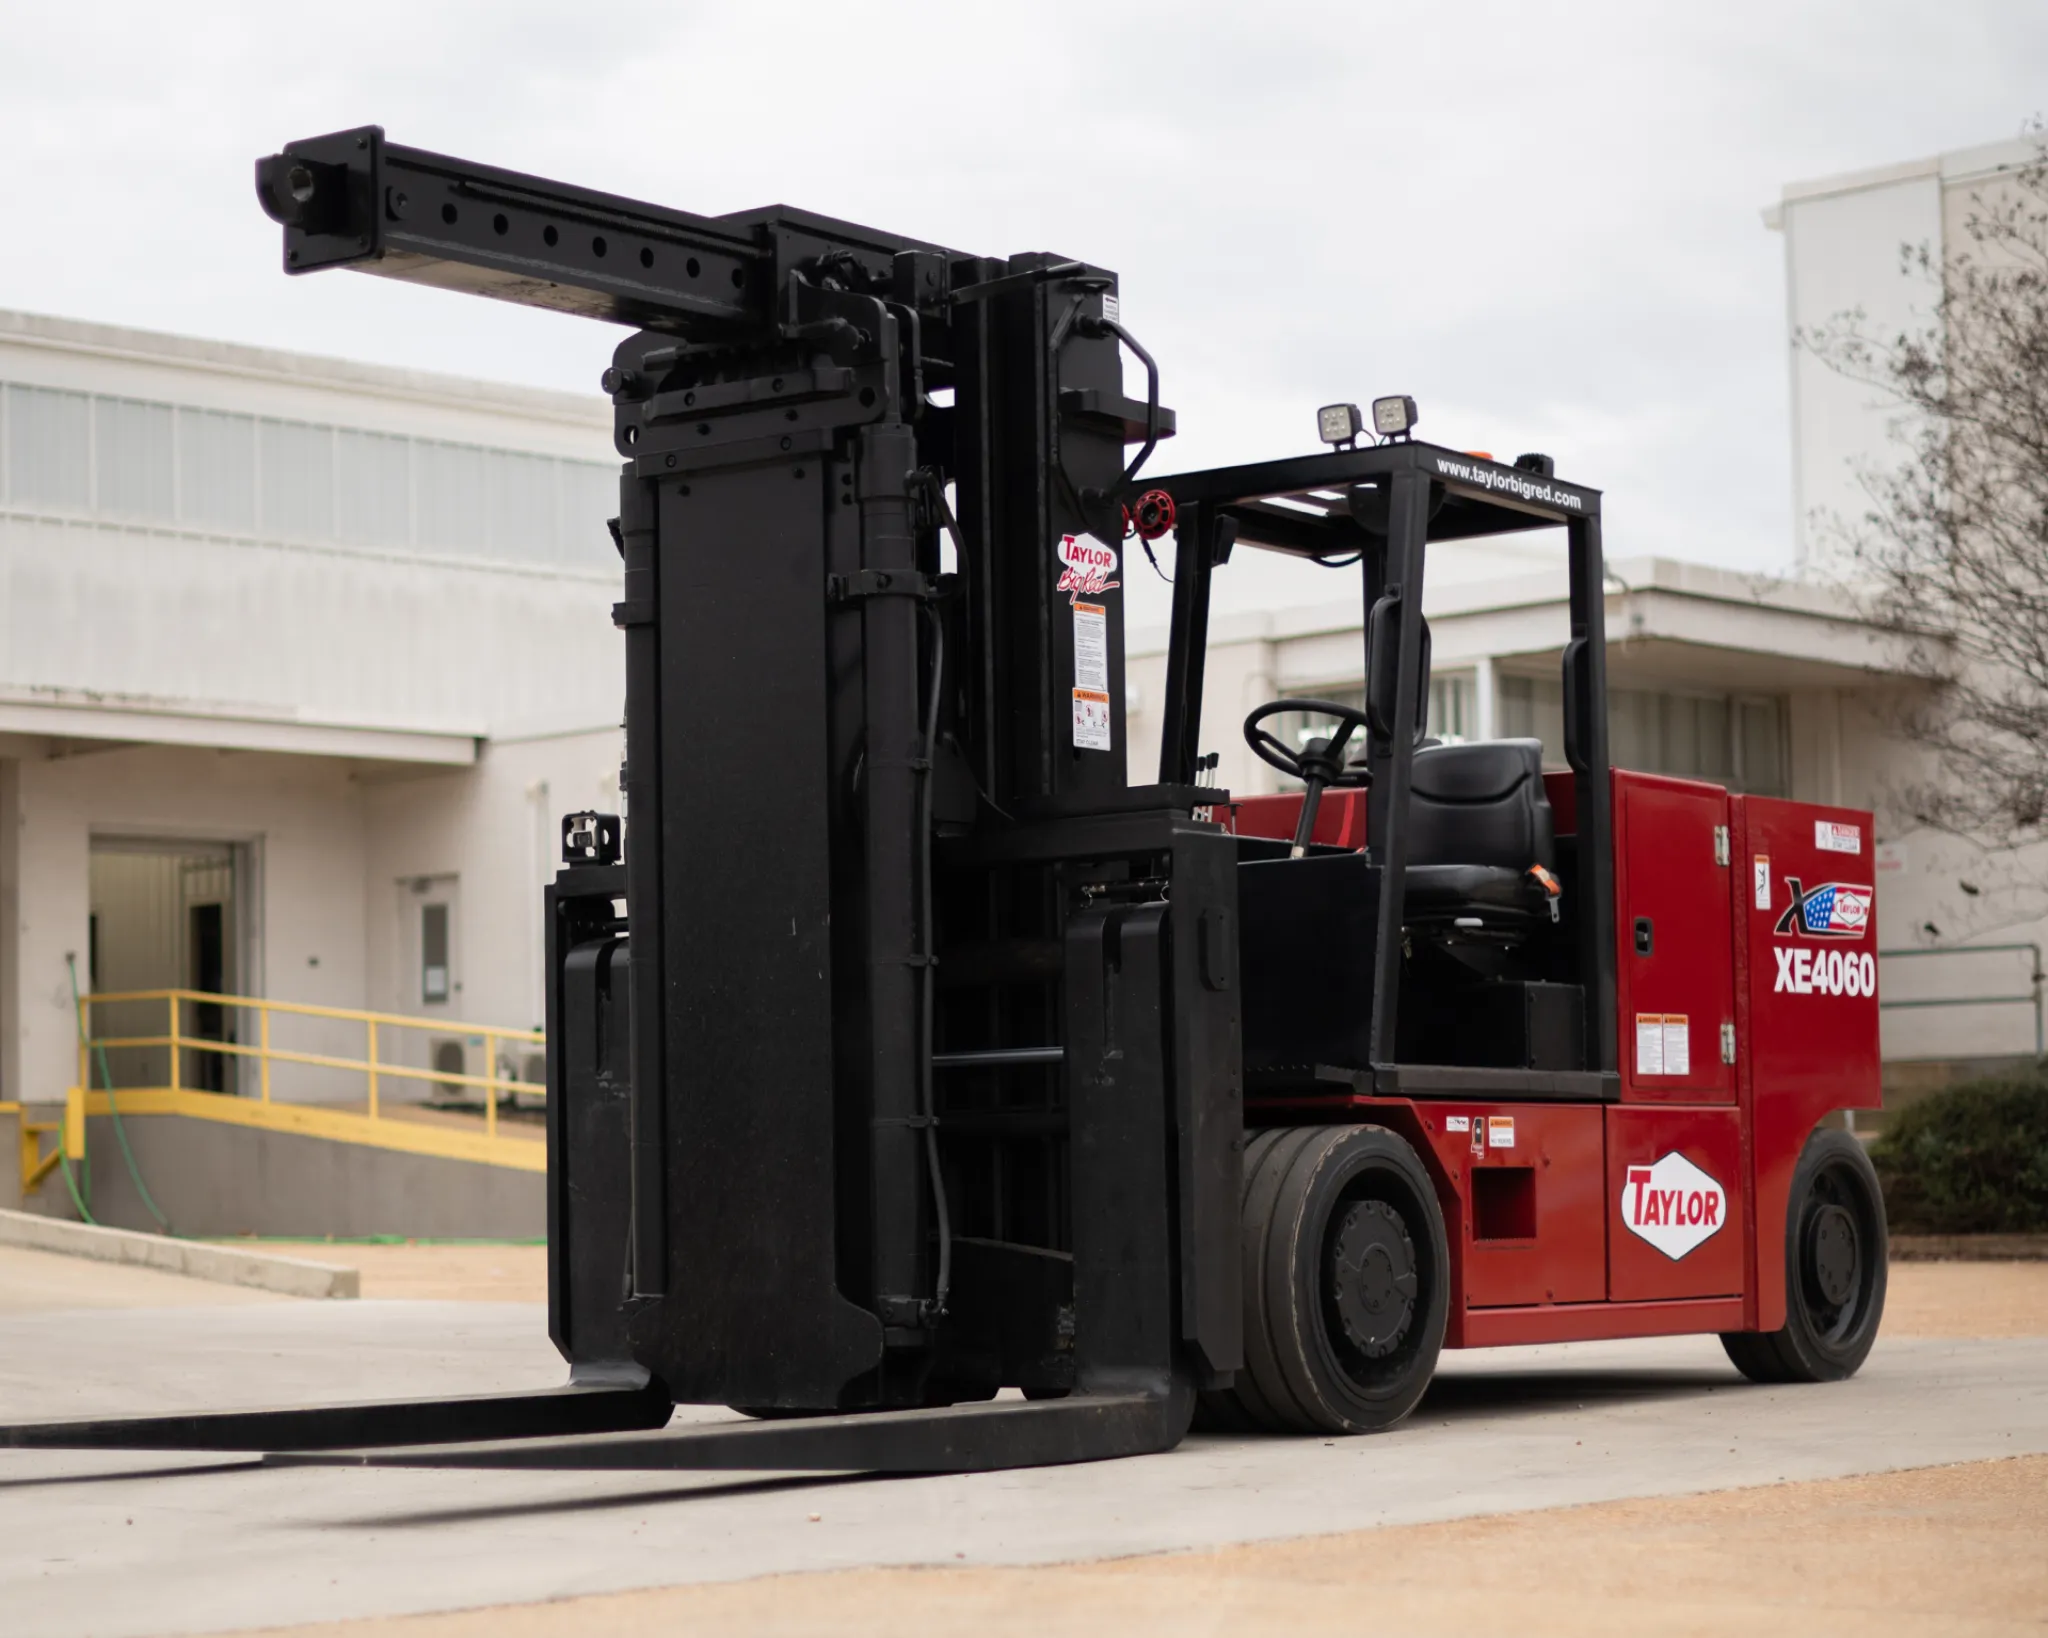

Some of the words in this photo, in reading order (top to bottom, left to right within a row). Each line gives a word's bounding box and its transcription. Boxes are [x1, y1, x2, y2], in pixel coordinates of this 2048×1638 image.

[1436, 458, 1582, 510] www.taylorbigred.com
[1063, 535, 1112, 568] TAYLOR
[1773, 947, 1875, 997] XE4060
[1629, 1169, 1719, 1226] TAYLOR
